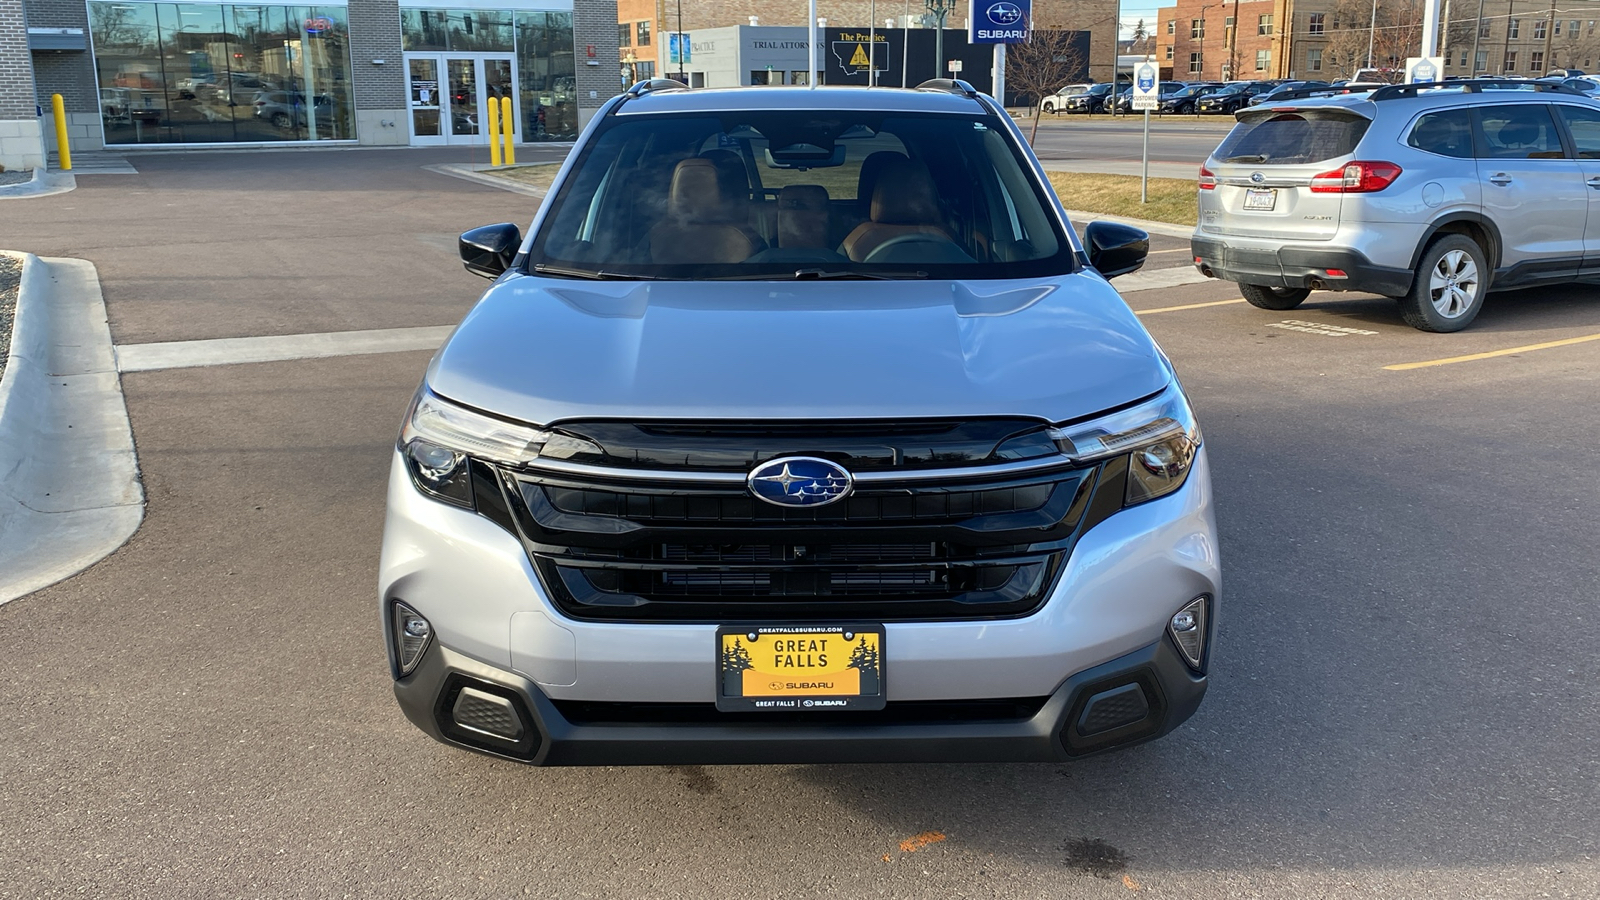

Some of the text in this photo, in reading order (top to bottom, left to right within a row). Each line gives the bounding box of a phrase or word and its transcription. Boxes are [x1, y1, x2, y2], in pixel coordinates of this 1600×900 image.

[840, 33, 885, 42] The Praice
[977, 30, 1027, 39] SUBARU
[753, 41, 825, 50] TRIAL ATTORNYS
[774, 640, 828, 652] GREAT
[774, 654, 828, 668] FALLS
